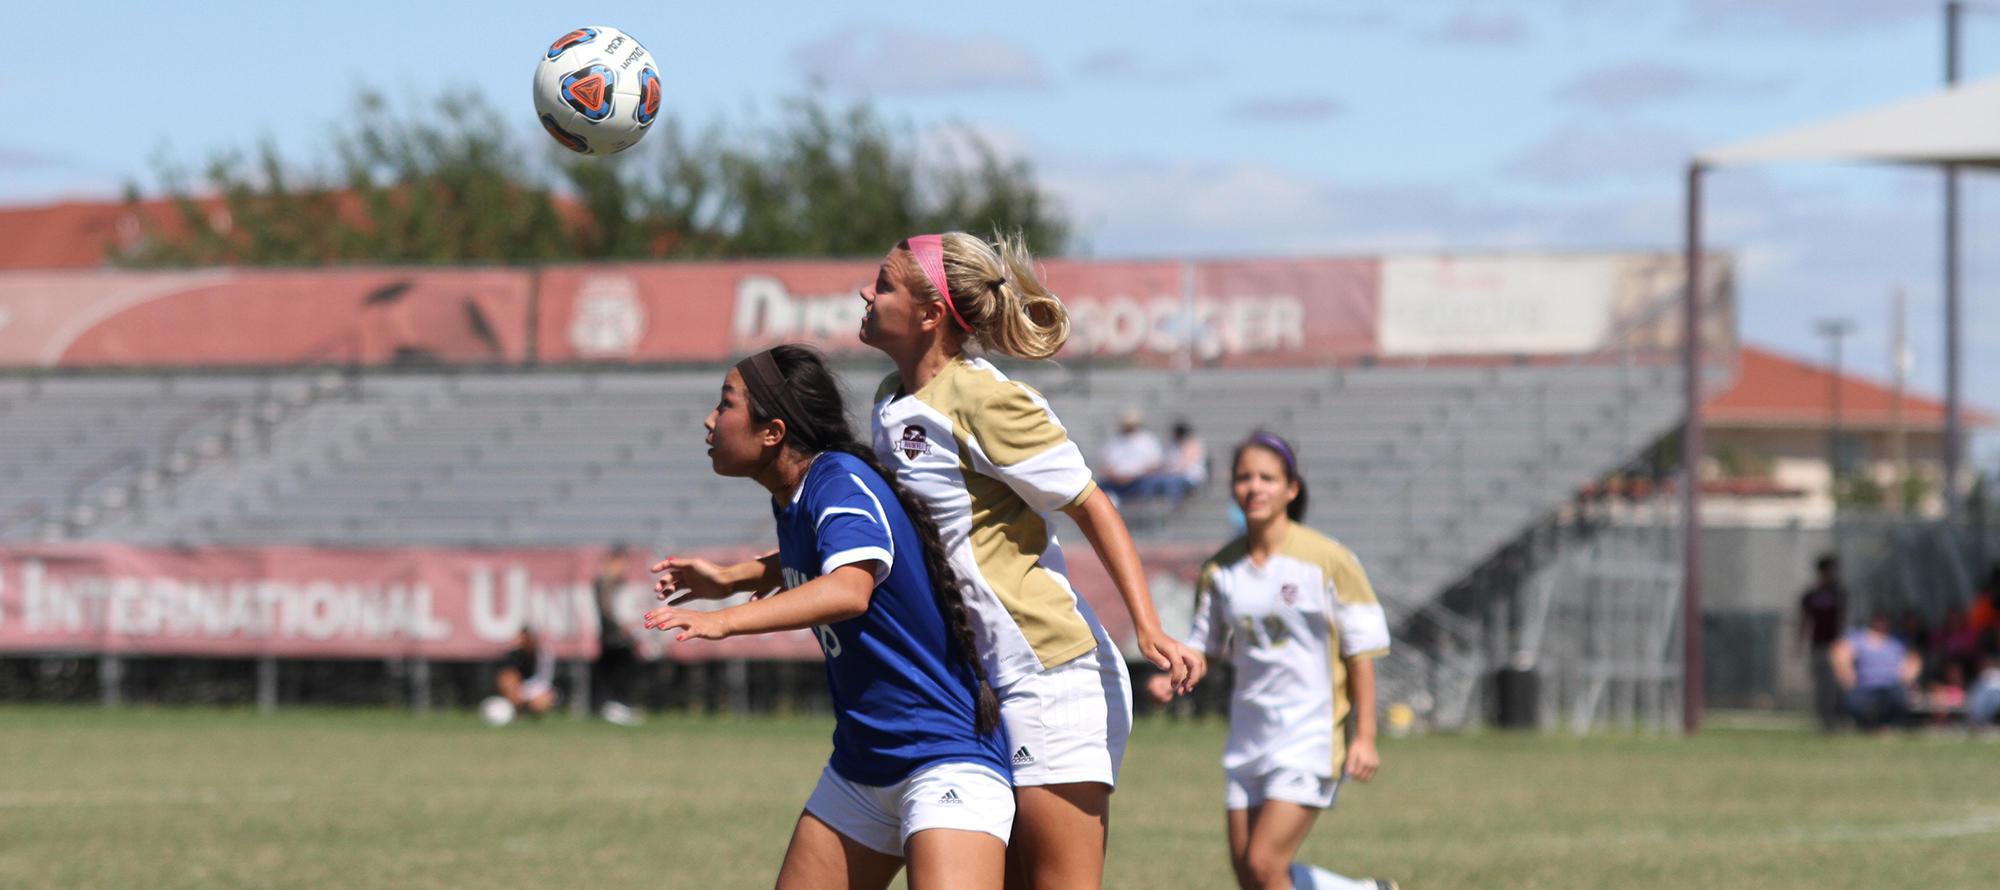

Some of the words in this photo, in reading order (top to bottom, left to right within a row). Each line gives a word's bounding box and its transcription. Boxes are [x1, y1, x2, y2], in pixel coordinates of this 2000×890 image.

[604, 34, 626, 55] NCAA
[620, 46, 645, 70] Wilson
[1066, 296, 1306, 354] SOCCER
